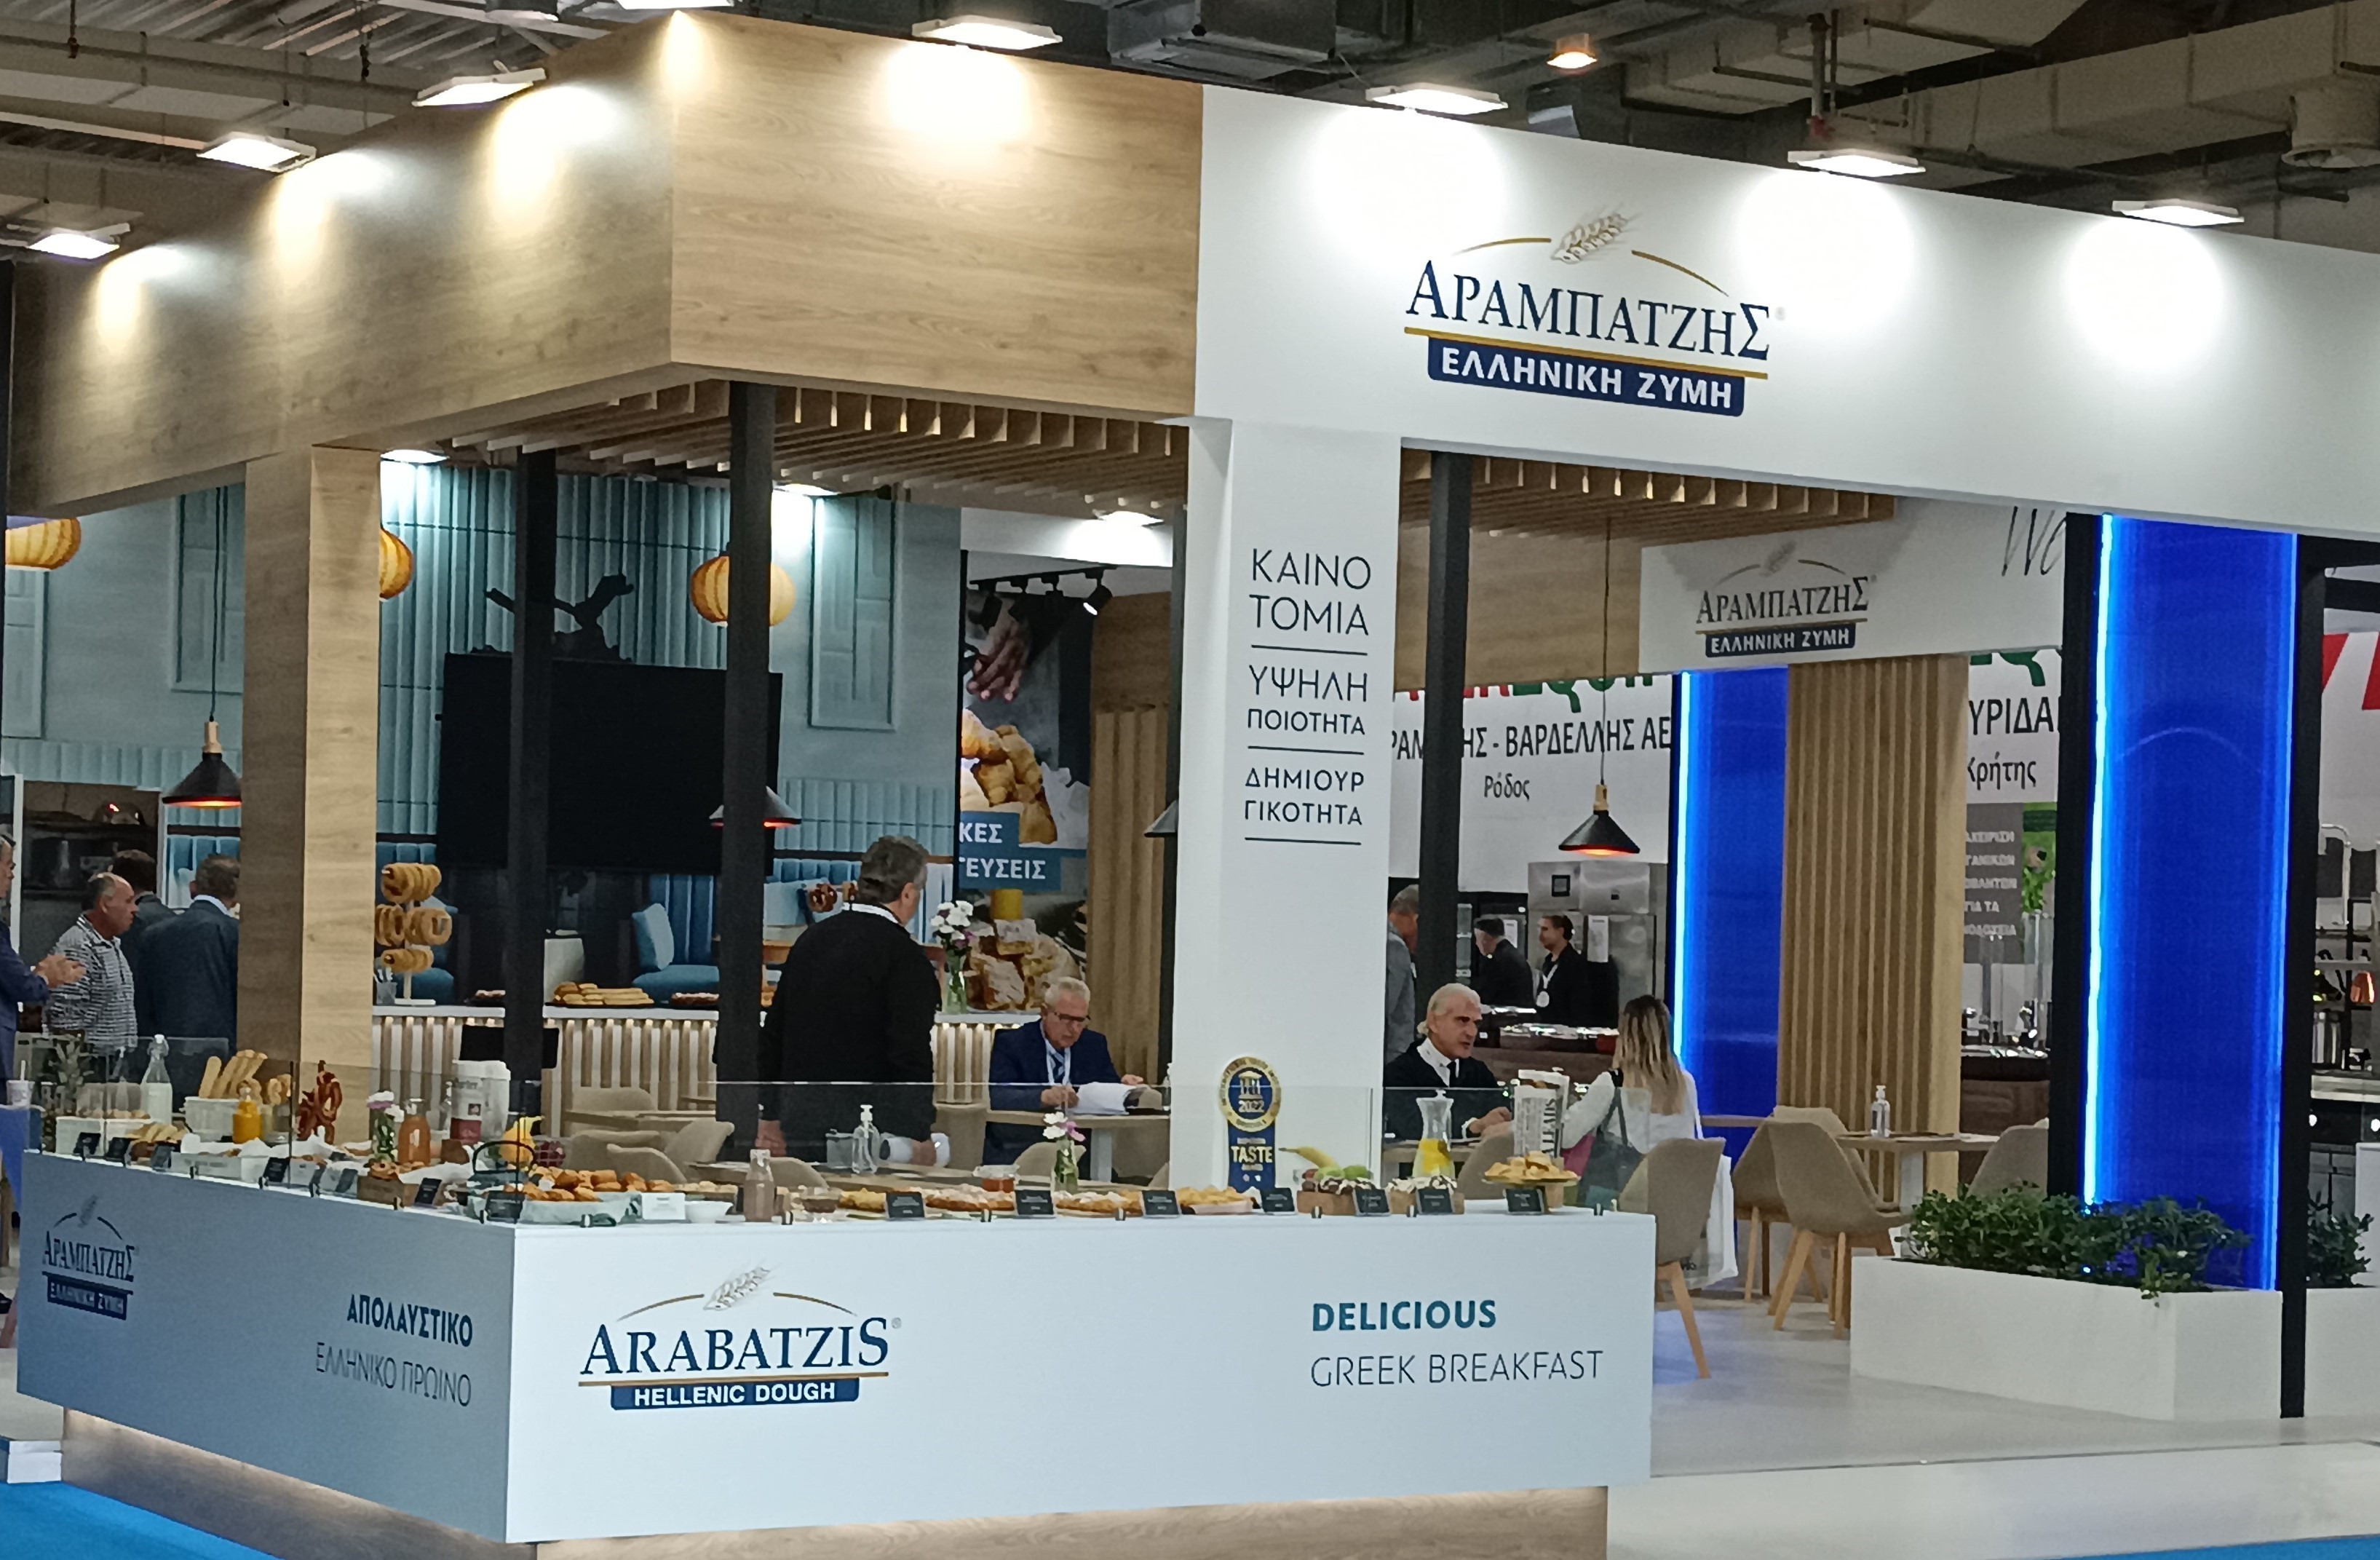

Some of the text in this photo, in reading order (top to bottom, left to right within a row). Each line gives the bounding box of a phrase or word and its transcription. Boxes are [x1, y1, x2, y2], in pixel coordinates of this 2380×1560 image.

[1406, 259, 1770, 361] ΑΡΑΜΠΑΤΖΗΣ
[1441, 347, 1732, 408] ΕΛΛΗΝΙΚΗ ΖΥΜΗ
[1253, 548, 1371, 590] ΚΑΙΝΟ
[1249, 594, 1368, 636] ΤΟΜΙΑ
[1696, 576, 1869, 624] ΑΡΑΜΠΑΤΖΗΣ
[1711, 628, 1849, 654] ΕΛΛΗΝΙΚΗ ΖΥΜΗ
[1248, 665, 1368, 702] ΥΨΗΛΗ
[1247, 708, 1365, 735] ΠΟΙΟΤΗΤΑ
[1506, 718, 1635, 757] ΒΑΡΔΕΛΛΗΣ
[1641, 716, 1671, 750] ΑΕ
[1245, 767, 1365, 792] ΔΗΜΙΟΥΡ
[1484, 772, 1530, 801] Ρόδος
[1245, 800, 1362, 825] ΓΙΚΟΤΗΤΑ
[1231, 1146, 1273, 1163] TASTE
[346, 1294, 473, 1347] ΑΠΟΛΑΥΣΤΙΚΟ
[1312, 1299, 1496, 1331] DELICIOUS
[580, 1316, 889, 1374] ARABATZIS
[316, 1342, 472, 1406] ΕΛΛΗΝΙΚΟ ΠΡΩΙΝΟ
[1311, 1350, 1603, 1387] GREEK BREAKFAST
[635, 1383, 835, 1406] HELLENIC DOUGH
